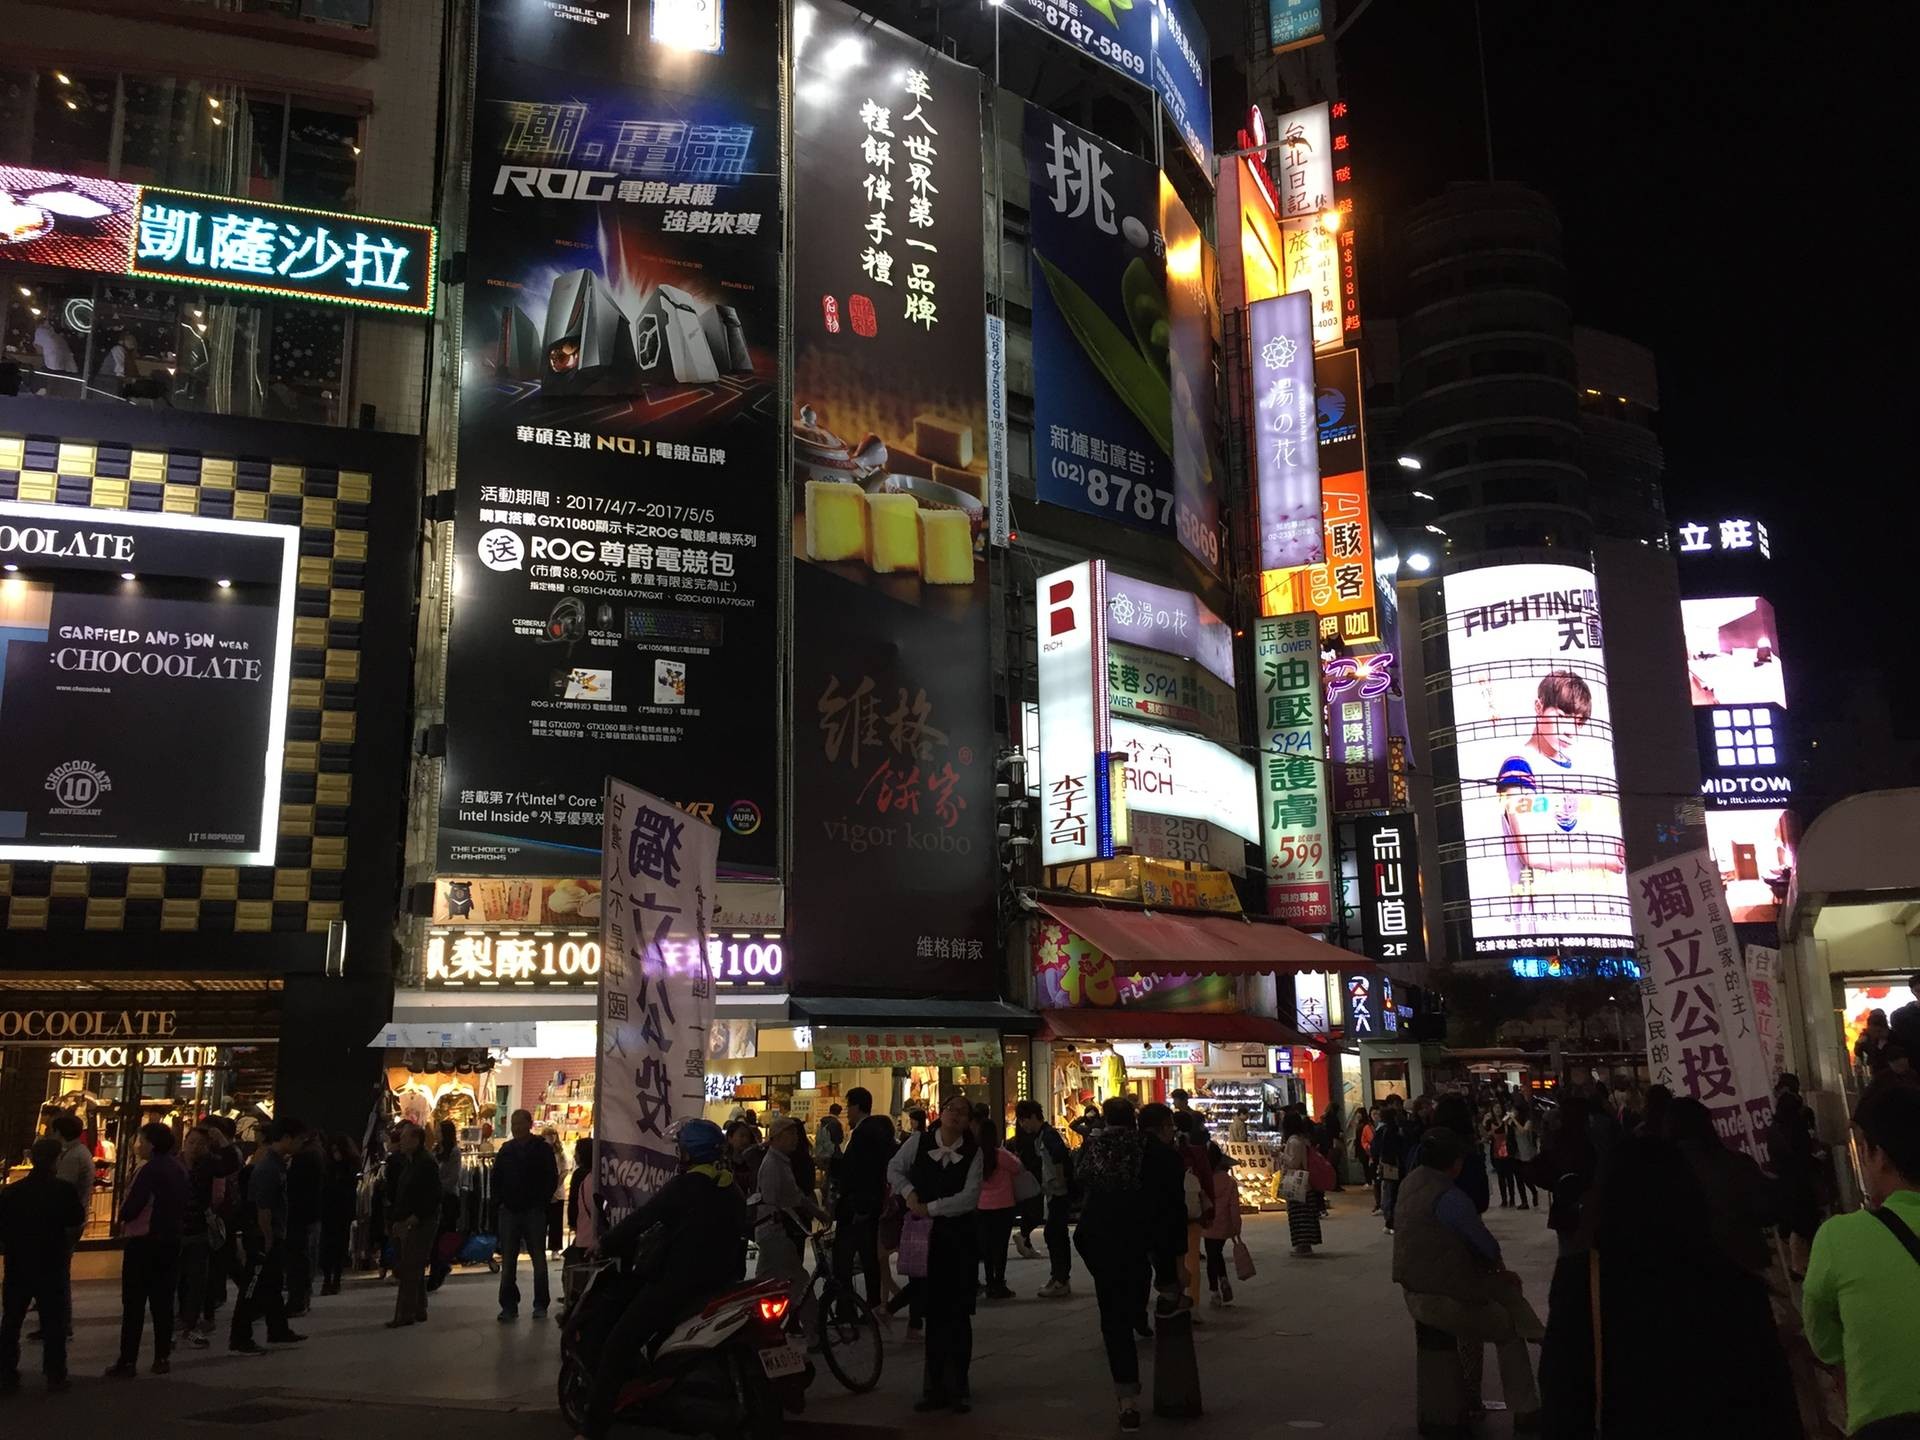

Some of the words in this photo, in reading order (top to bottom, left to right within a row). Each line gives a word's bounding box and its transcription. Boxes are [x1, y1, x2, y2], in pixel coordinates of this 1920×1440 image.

[554, 10, 598, 25] GAMERS
[1046, 5, 1145, 74] 8787-5869
[492, 165, 619, 201] ROG
[617, 180, 718, 206] 電競桌機
[1045, 123, 1118, 236] 挑
[903, 68, 939, 332] 華人世界第一品牌
[662, 210, 761, 235] 強勢來襲
[138, 204, 411, 292] 凱薩沙拉
[1269, 380, 1298, 469] 湯の花
[517, 425, 591, 449] 華碩全球
[597, 434, 651, 457] NO.1
[656, 442, 726, 465] 電競品牌
[1051, 457, 1085, 486] (02)
[567, 495, 715, 523] 2017/4/7~2017/5/5
[486, 535, 518, 565] 送
[1679, 519, 1753, 551] 立莊
[531, 536, 595, 563] ROG
[599, 541, 735, 577] 尊爵電競包
[1333, 523, 1363, 599] 駭客
[1137, 601, 1189, 638] 湯の花
[1466, 589, 1582, 637] FIGHTING
[145, 632, 180, 646] AND
[219, 641, 249, 650] WEAR
[1260, 618, 1311, 643] 玉芙蓉
[1043, 640, 1063, 653] RICH
[1259, 639, 1312, 657] U-FLOWER
[1143, 673, 1177, 700] SPA
[1264, 657, 1314, 730] 油壓
[817, 674, 948, 768] 維格
[1269, 730, 1313, 752] SPA
[63, 778, 92, 801] 10
[1125, 768, 1173, 794] RICH
[1268, 754, 1318, 830] 護膚
[1353, 787, 1369, 799] 3F
[459, 809, 488, 822] Intel
[568, 796, 597, 807] Core
[1050, 775, 1088, 846] 李奇
[732, 813, 756, 823] AURA
[1165, 818, 1208, 842] 250
[823, 816, 896, 852] vigor
[905, 822, 971, 856] kobo
[1167, 839, 1209, 863] 350
[1272, 837, 1322, 869] $599
[916, 935, 983, 961] 維格餅家
[1382, 943, 1408, 956] 2F
[1693, 858, 1750, 1039] 人民是國家的主人
[1639, 866, 1736, 1101] 獨立公投
